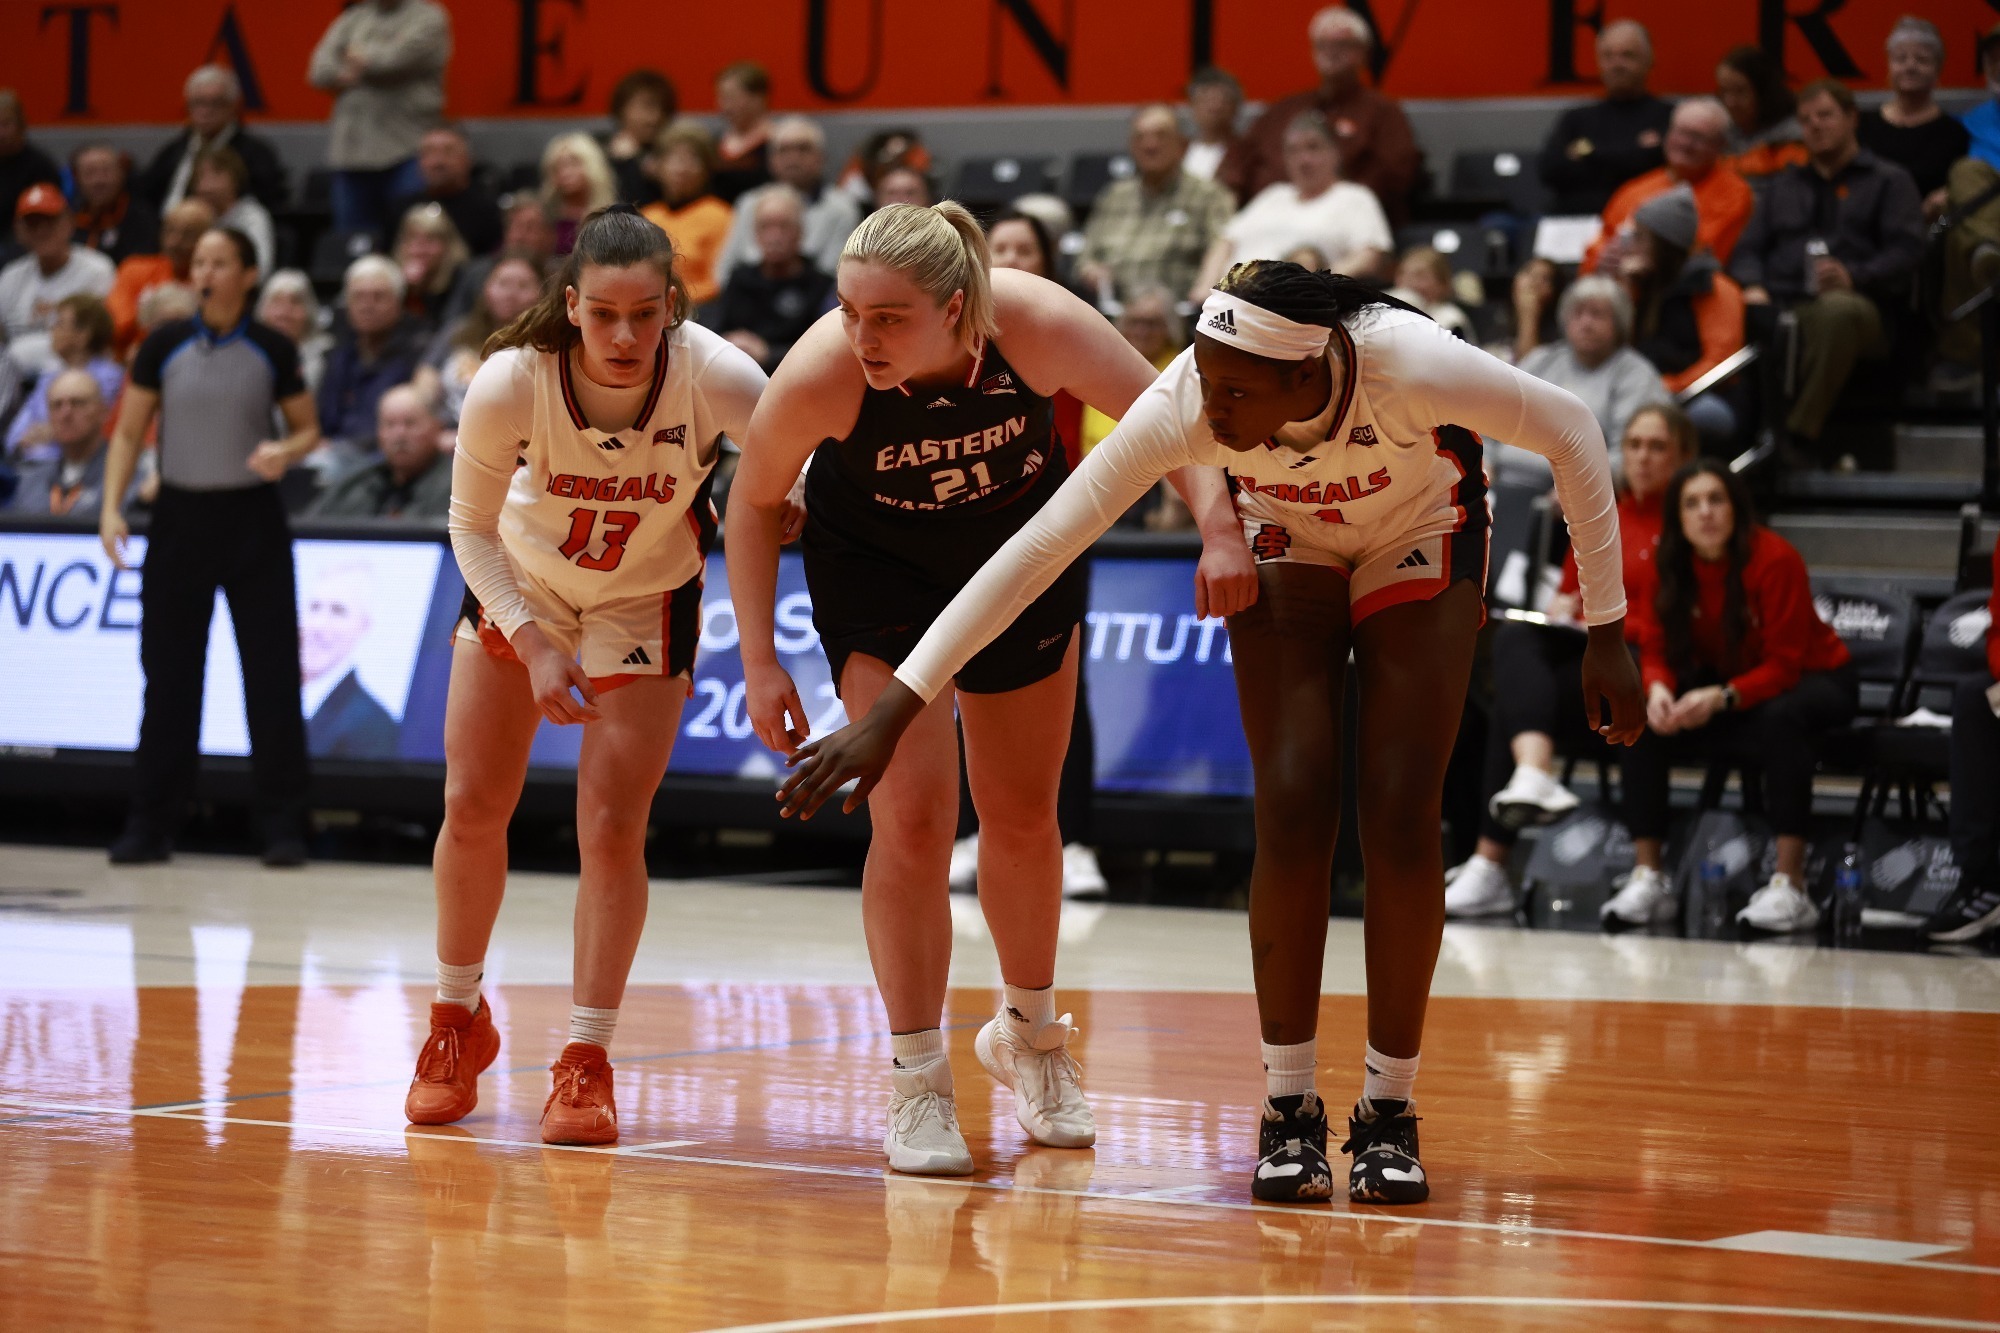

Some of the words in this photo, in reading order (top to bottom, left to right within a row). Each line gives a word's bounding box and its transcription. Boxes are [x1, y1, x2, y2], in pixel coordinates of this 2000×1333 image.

[804, 0, 2000, 102] UNIVER
[1207, 319, 1238, 336] adidas
[875, 415, 1027, 472] EASTERN
[546, 472, 677, 505] ENGALS
[930, 461, 992, 503] 21
[558, 507, 641, 572] 13
